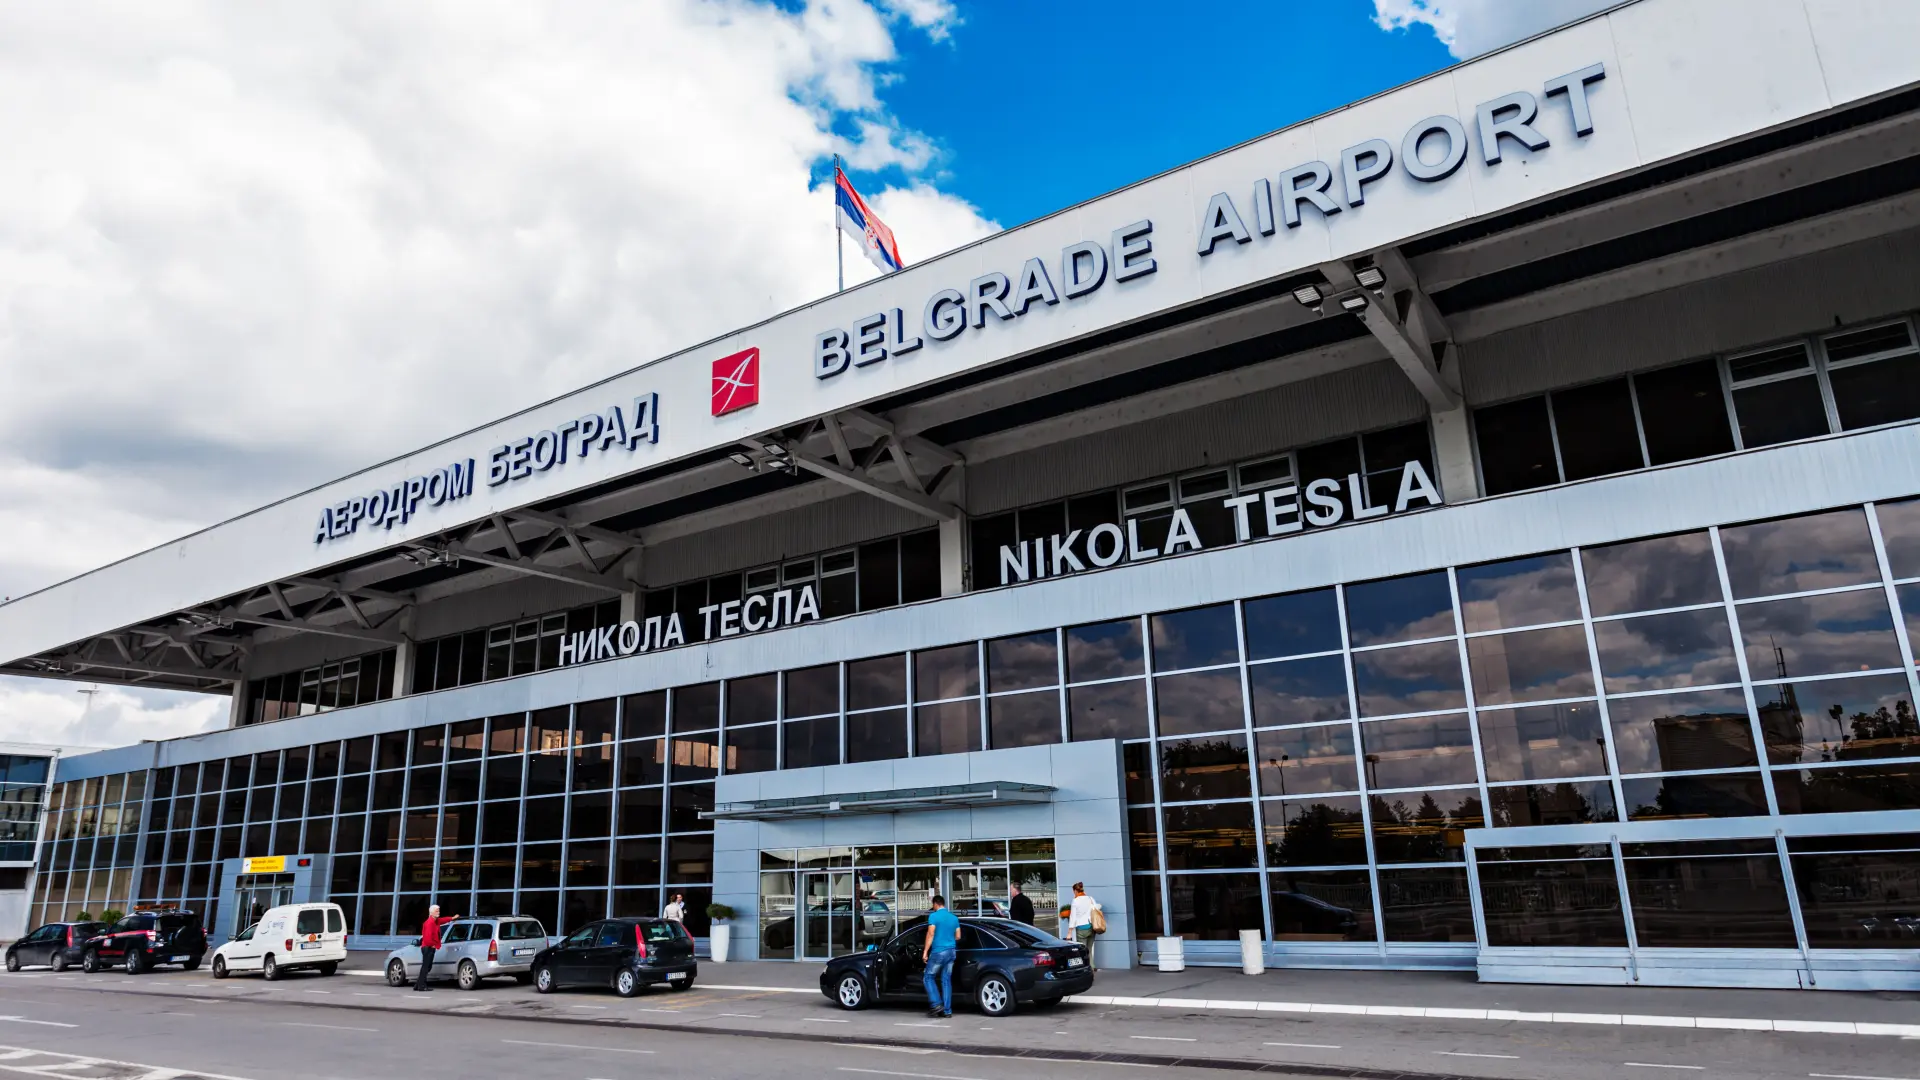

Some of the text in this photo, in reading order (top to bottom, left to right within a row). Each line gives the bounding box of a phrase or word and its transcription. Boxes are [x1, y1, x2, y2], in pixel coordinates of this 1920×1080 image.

[815, 62, 1606, 380] BELGRADE AIRPORT
[313, 392, 659, 544] АЕРОДРОМ БЕОГРАД
[1000, 459, 1443, 585] NIKOLA TESLA
[558, 585, 820, 666] НИКОЛА ТЕСЛА
